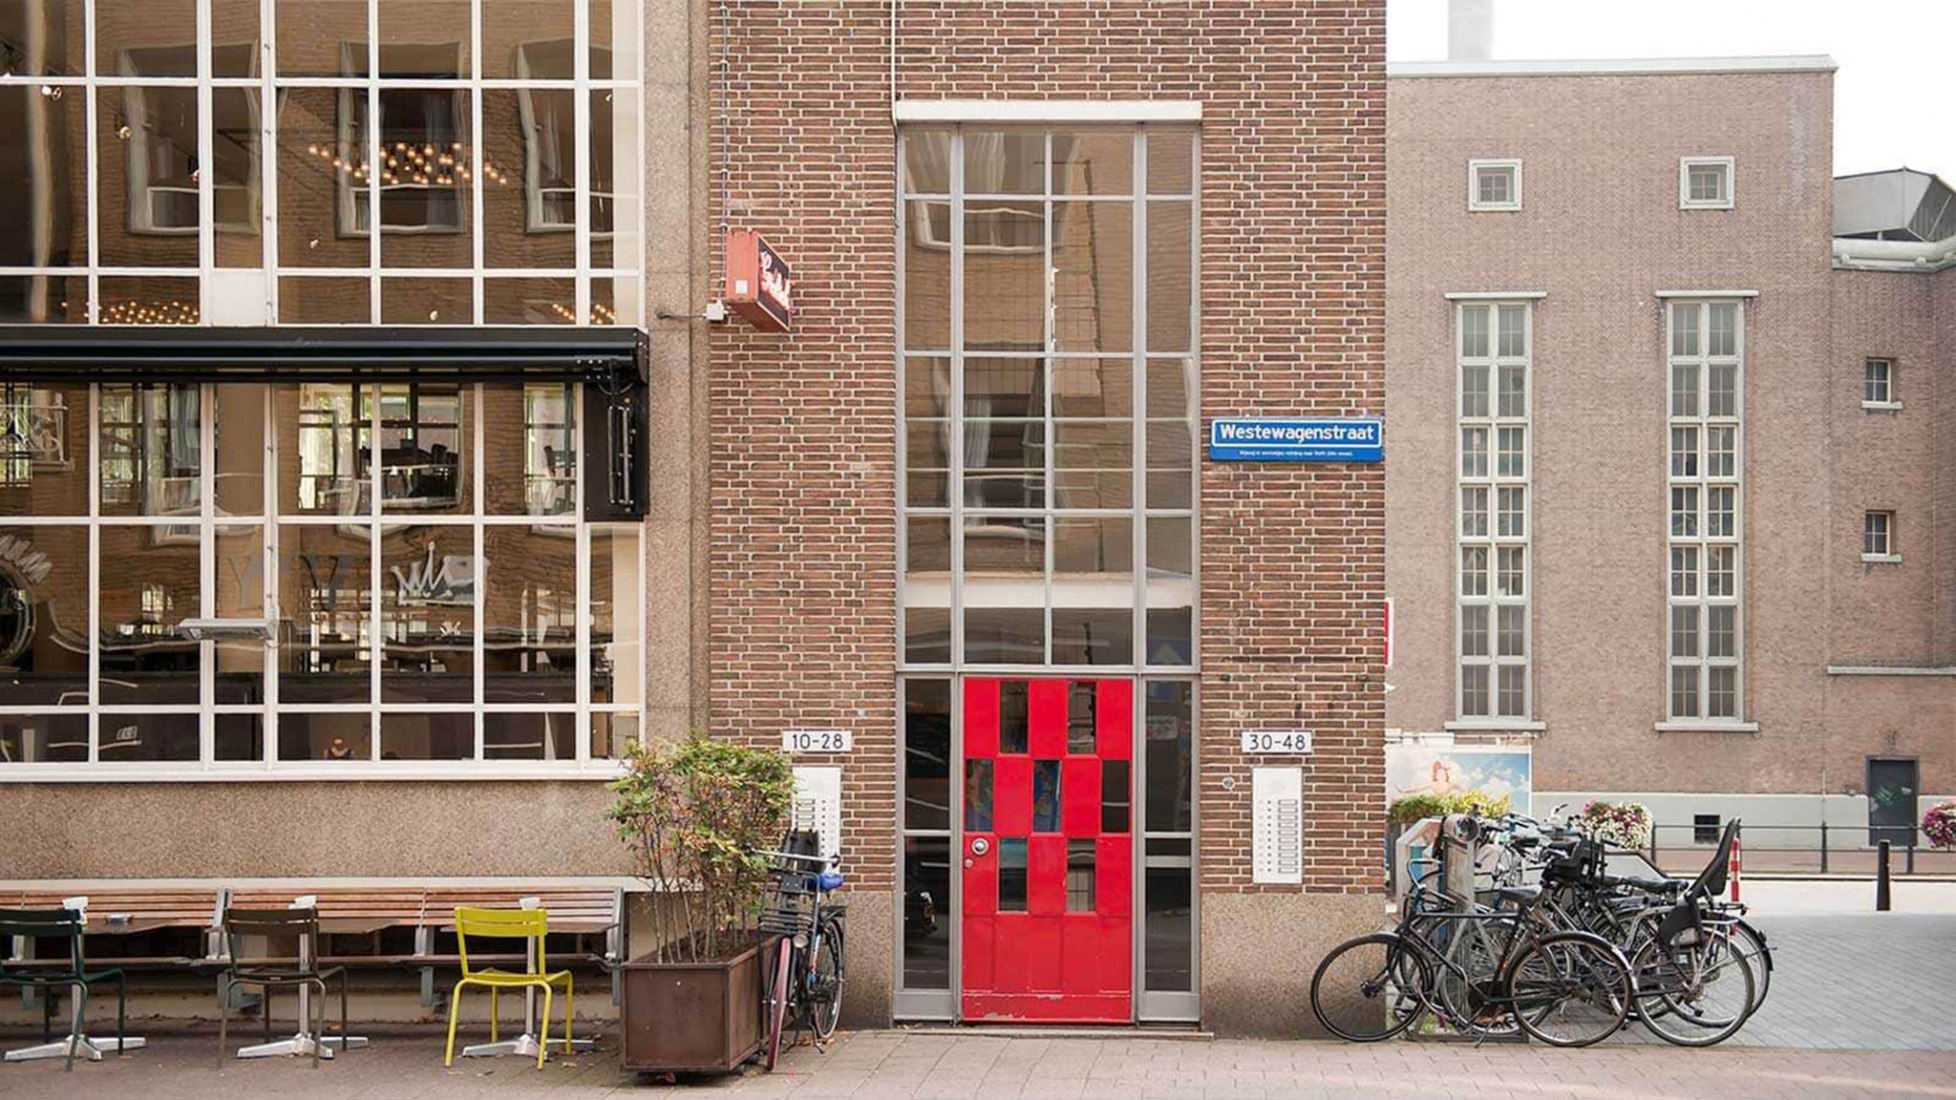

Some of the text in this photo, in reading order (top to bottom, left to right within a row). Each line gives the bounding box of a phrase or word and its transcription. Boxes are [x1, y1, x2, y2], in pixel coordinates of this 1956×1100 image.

[1220, 424, 1374, 444] Westewagenstraat
[792, 733, 844, 750] 10-28
[1249, 734, 1306, 751] 30-48
